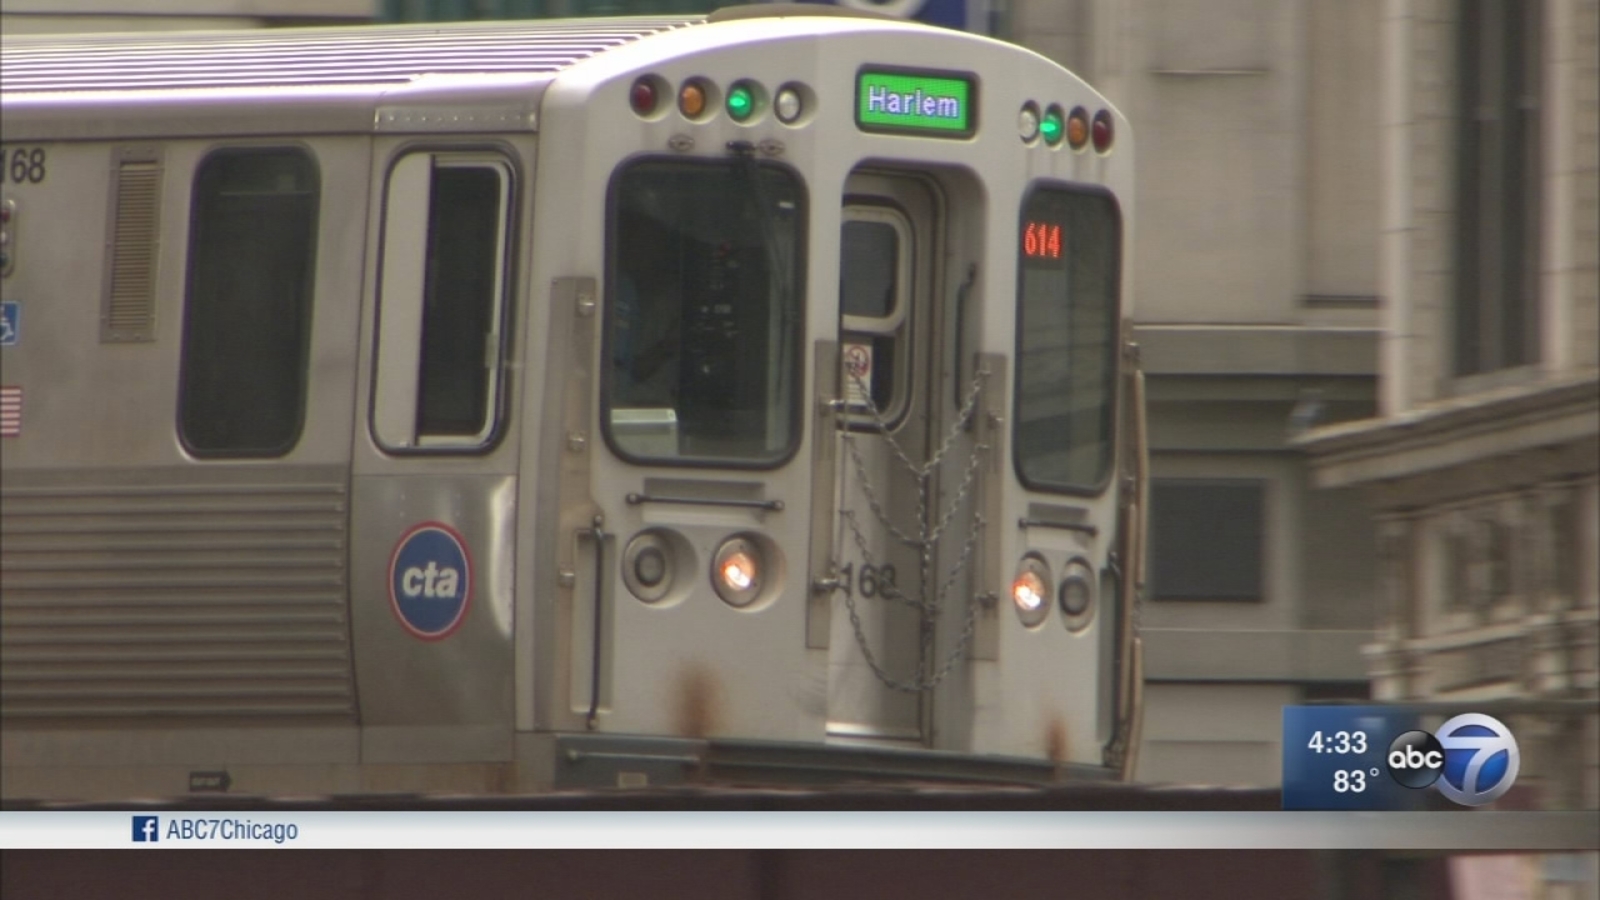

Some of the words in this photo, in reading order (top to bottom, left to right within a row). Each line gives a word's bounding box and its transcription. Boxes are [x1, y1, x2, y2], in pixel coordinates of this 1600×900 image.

[867, 85, 960, 119] Harlem
[1024, 222, 1062, 259] 614
[402, 561, 459, 598] cta
